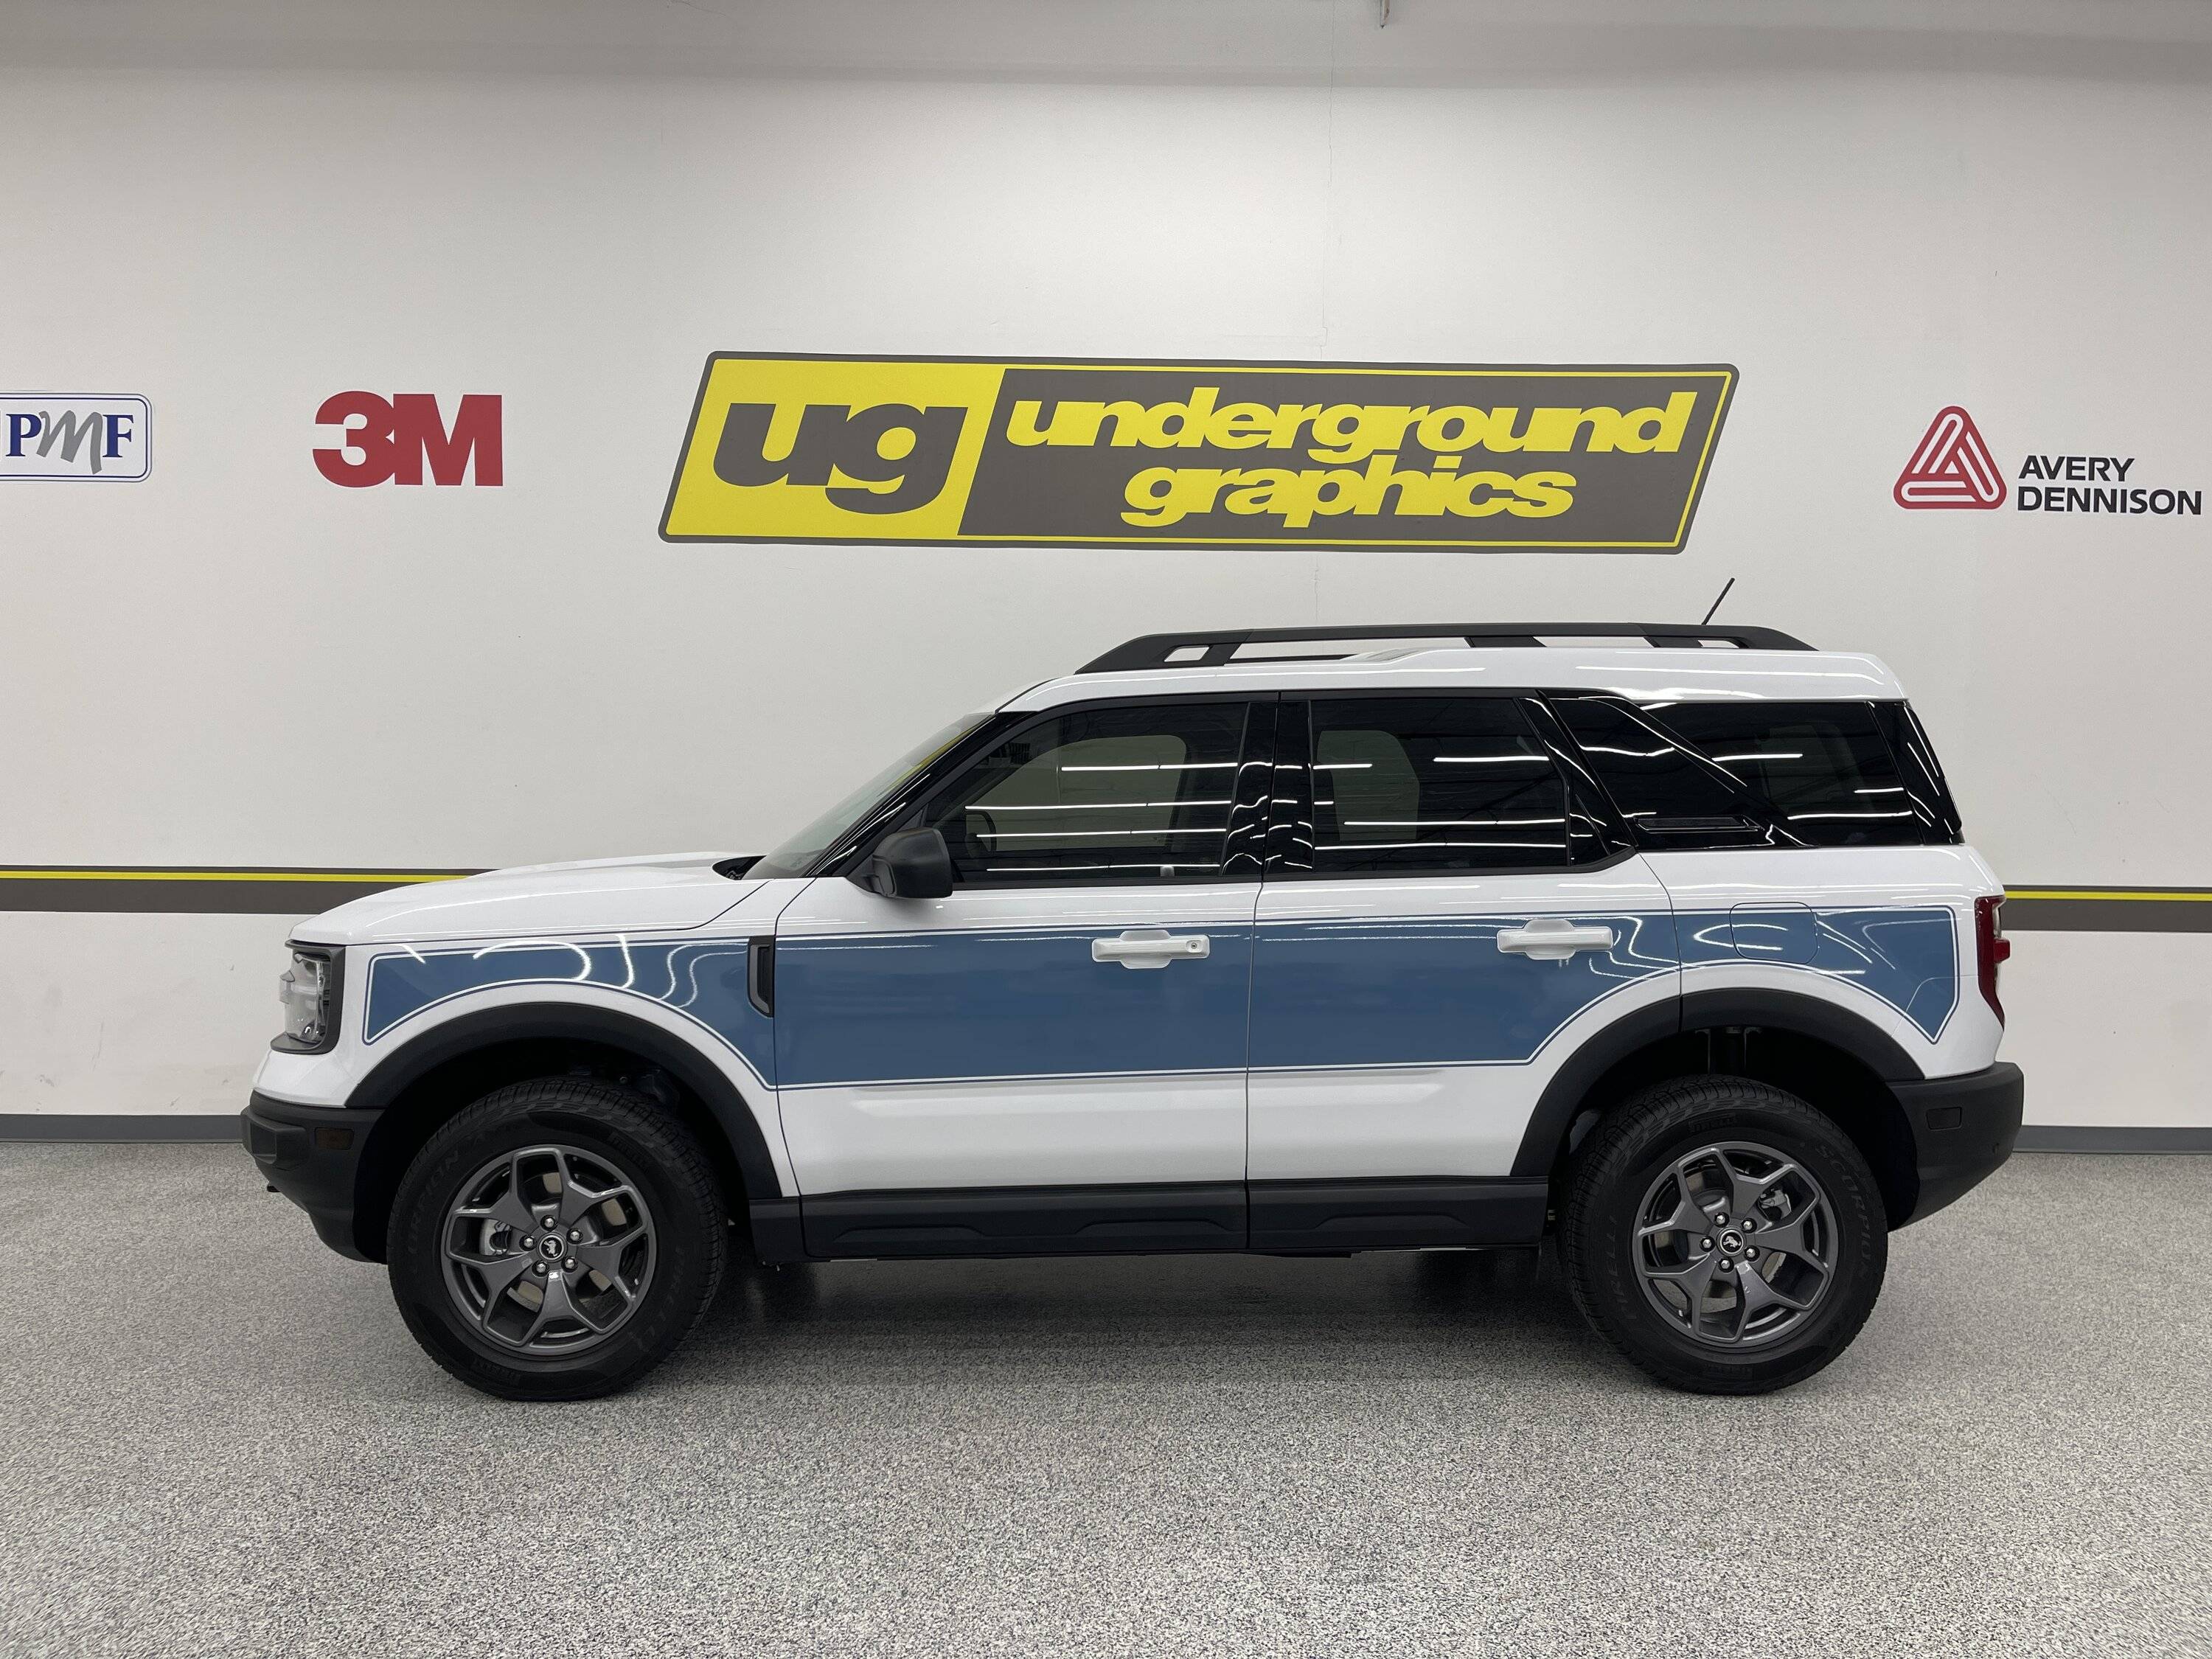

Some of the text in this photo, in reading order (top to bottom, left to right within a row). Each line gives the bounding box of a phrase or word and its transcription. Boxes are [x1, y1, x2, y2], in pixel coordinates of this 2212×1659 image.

[5, 410, 134, 475] PMF
[313, 391, 504, 487] 3M
[713, 403, 969, 515] ug
[1006, 386, 1697, 466] underground
[1120, 454, 1577, 529] graphics
[2017, 487, 2202, 515] DENNISON
[2018, 455, 2135, 482] AVERY
